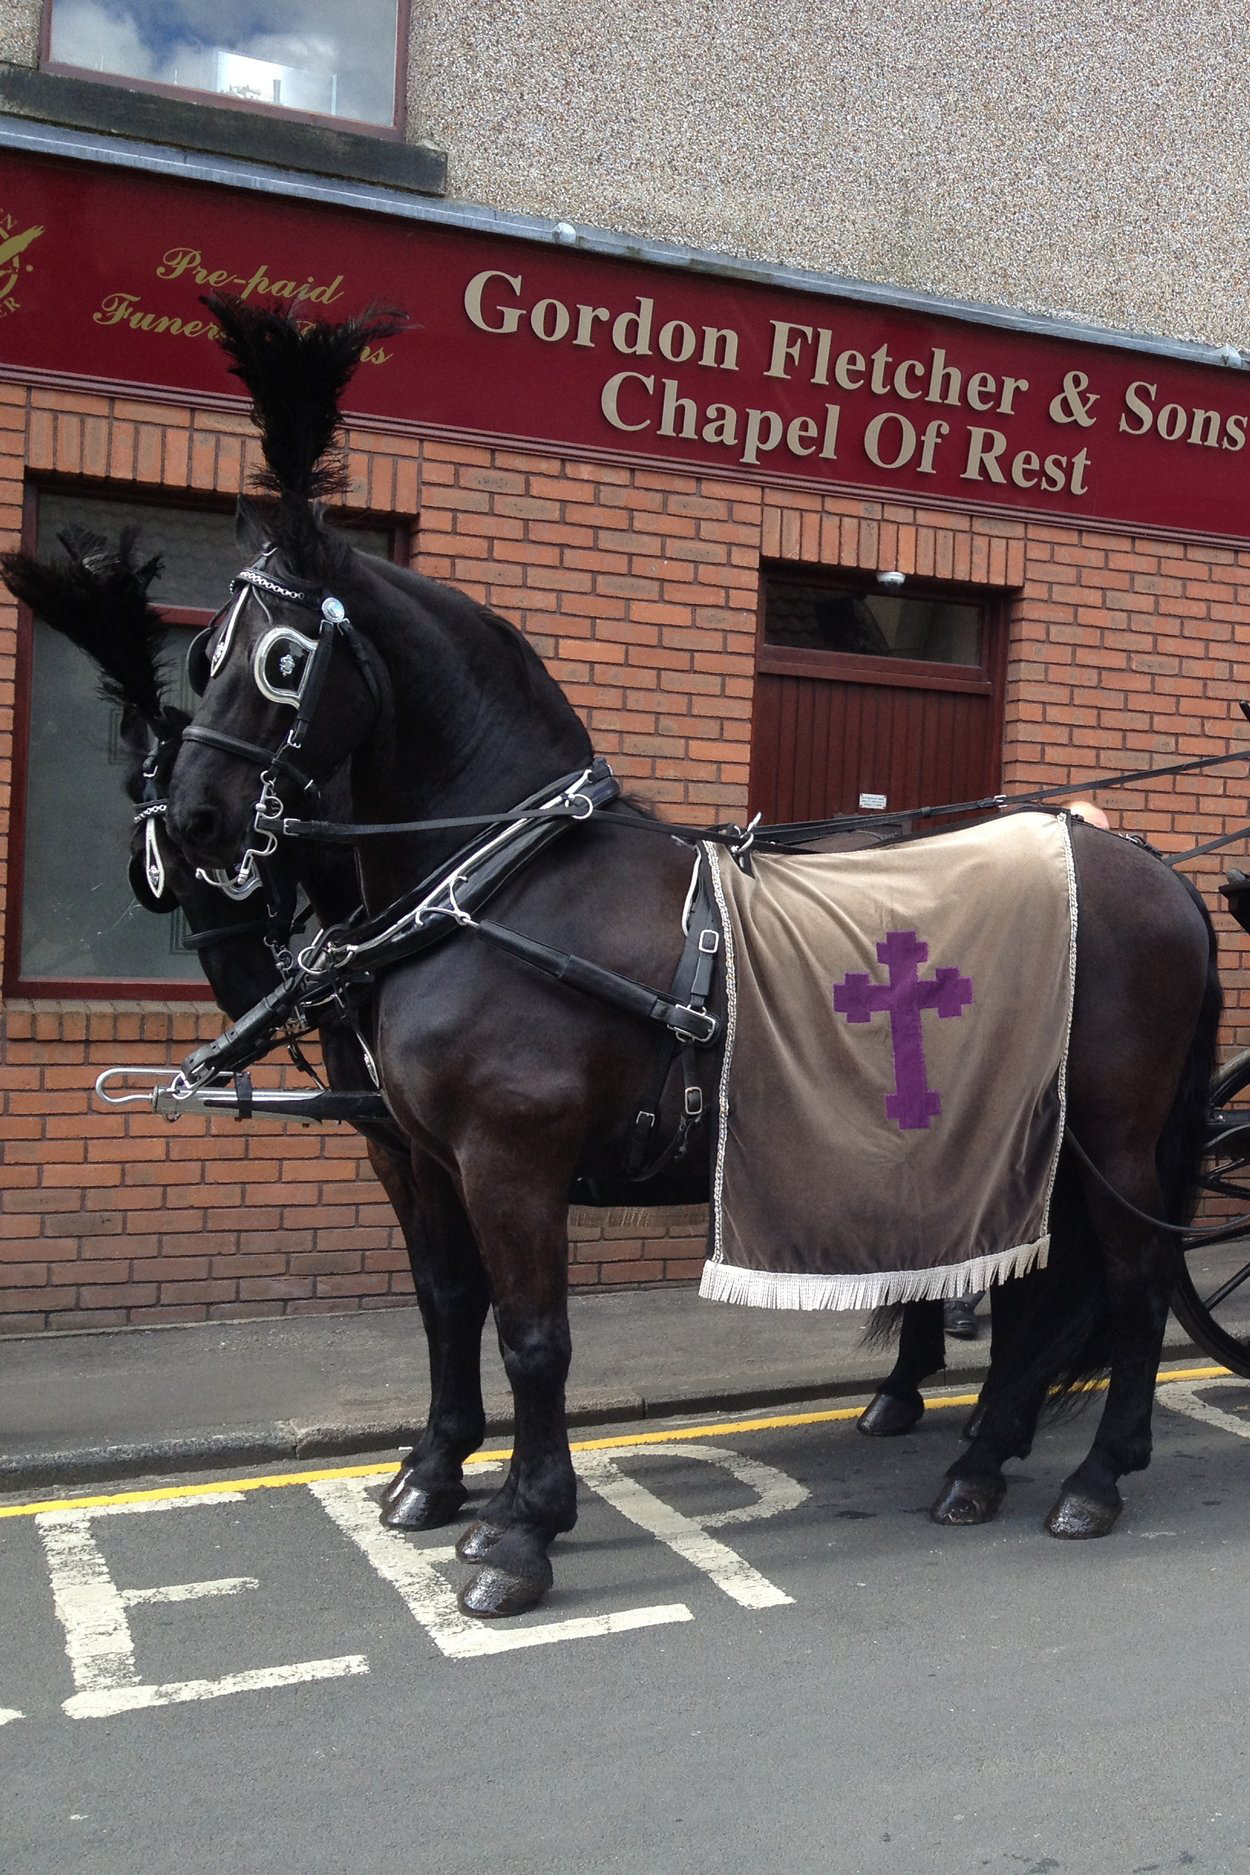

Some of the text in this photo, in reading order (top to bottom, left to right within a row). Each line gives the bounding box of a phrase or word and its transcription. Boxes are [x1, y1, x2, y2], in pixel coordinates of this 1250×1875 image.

[92, 292, 234, 341] Funer
[156, 247, 345, 305] Pre-paid
[464, 270, 740, 371] Gordon
[763, 320, 1029, 415] Fletcher
[1049, 370, 1100, 427] &
[1119, 381, 1248, 452] Sons
[601, 371, 1091, 495] Chapel Of Rest
